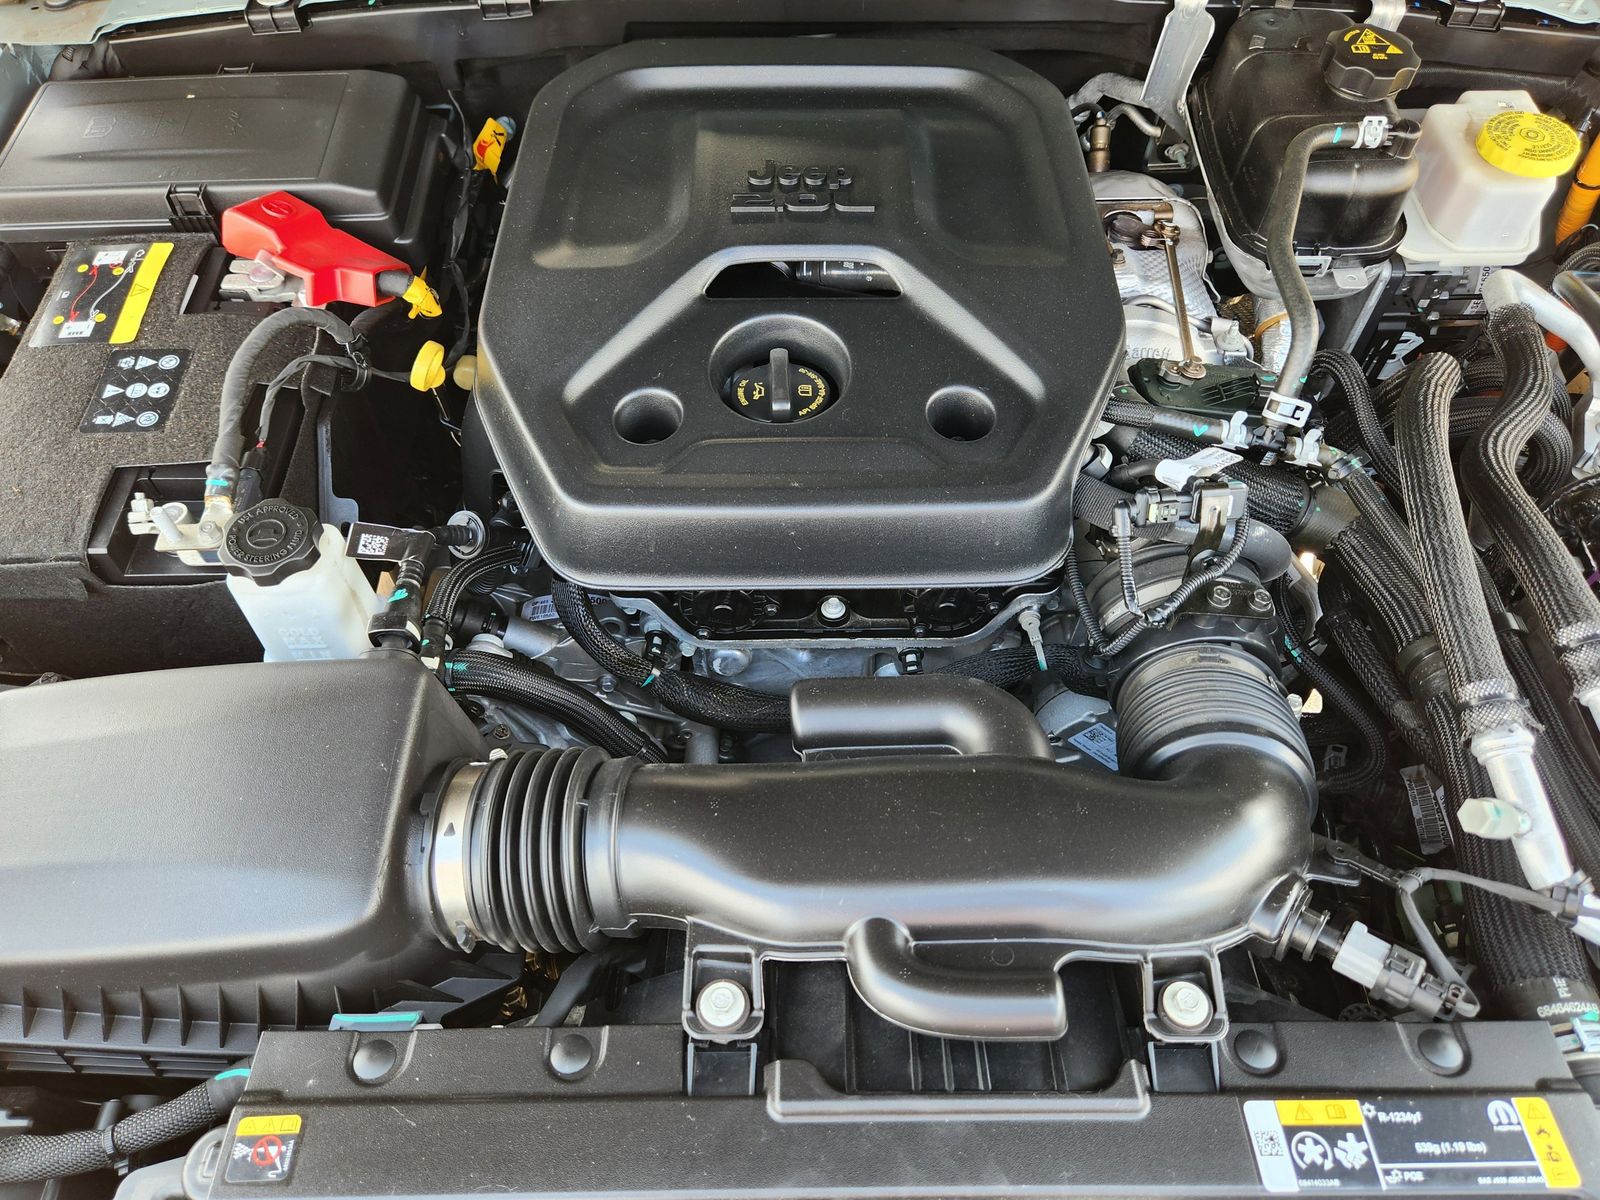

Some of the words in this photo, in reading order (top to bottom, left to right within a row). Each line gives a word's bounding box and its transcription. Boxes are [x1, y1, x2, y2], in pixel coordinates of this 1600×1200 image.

[747, 159, 854, 190] Jeep
[256, 504, 299, 520] APPROVED
[228, 534, 245, 558] POWER
[243, 548, 288, 563] STEERING
[287, 530, 303, 550] FLUID
[1378, 1111, 1423, 1124] R-1234yf
[1466, 1141, 1487, 1154] lbs)
